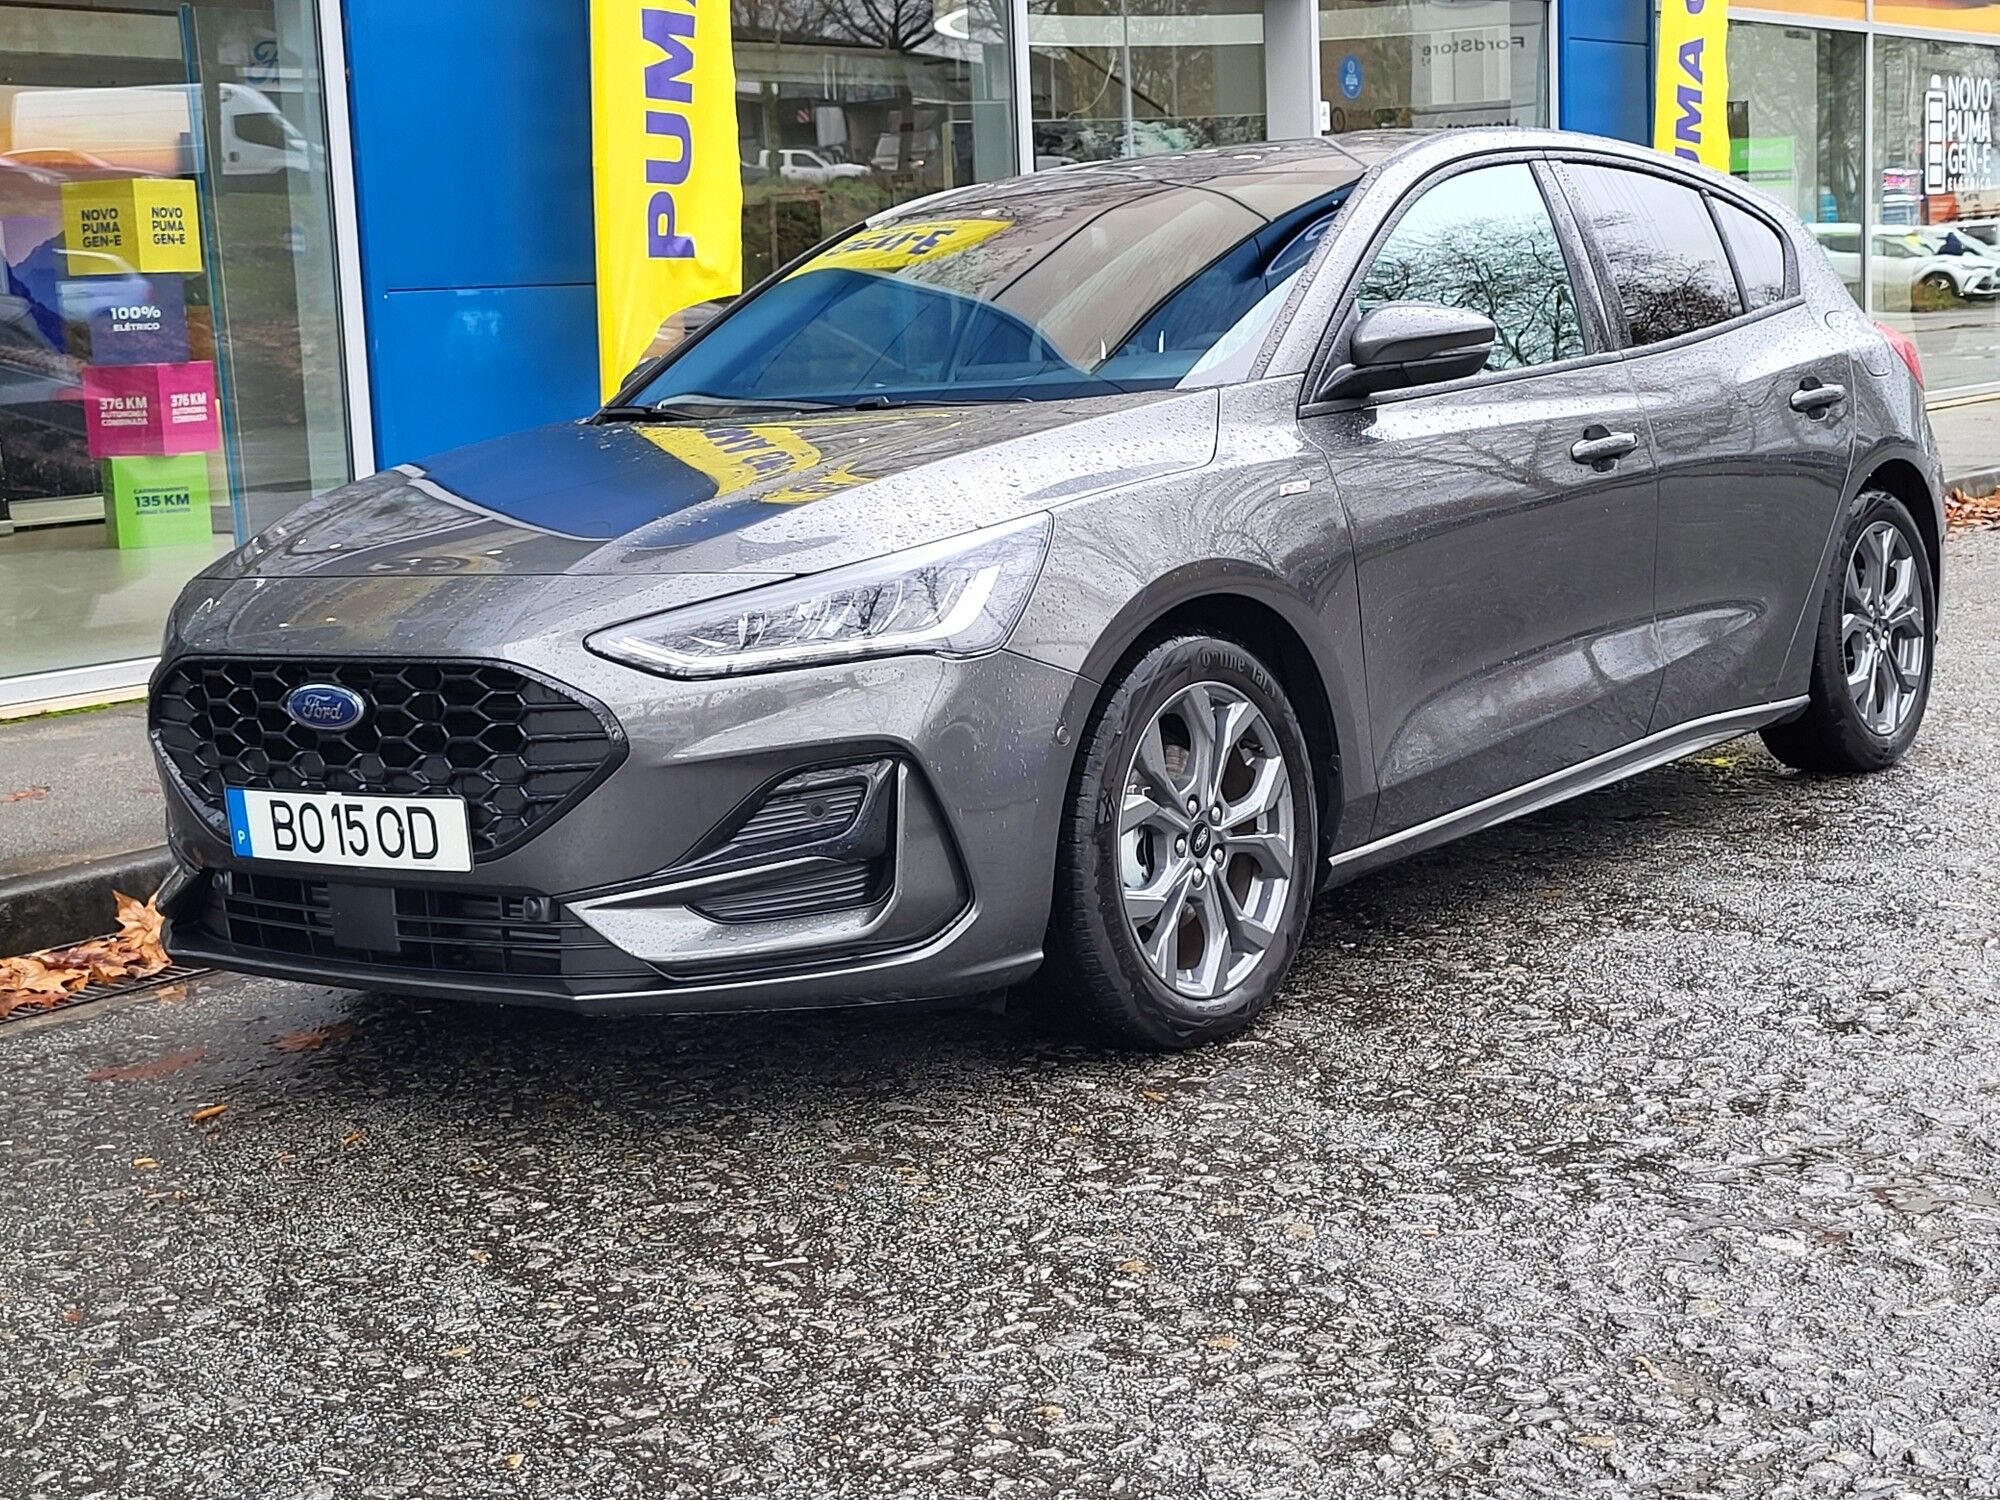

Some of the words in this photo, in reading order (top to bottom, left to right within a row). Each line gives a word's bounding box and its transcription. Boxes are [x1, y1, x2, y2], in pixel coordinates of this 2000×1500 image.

[1947, 75, 1992, 110] NOVO
[641, 0, 698, 259] PUM
[1947, 109, 1992, 142] PUMA
[1947, 142, 1992, 174] GEN-E
[81, 208, 119, 221] NOVO
[151, 207, 183, 218] NOVO
[82, 222, 121, 234] PUMA
[152, 220, 185, 231] PUMA
[83, 235, 122, 248] GEN-E
[153, 234, 186, 245] GEN-E
[110, 306, 162, 320] 100%
[99, 397, 124, 410] 376
[126, 396, 148, 409] KM
[170, 393, 189, 408] 376
[190, 392, 207, 406] KM
[134, 496, 161, 508] 135
[164, 493, 190, 506] KM
[302, 693, 343, 720] Ford
[237, 830, 246, 845] P
